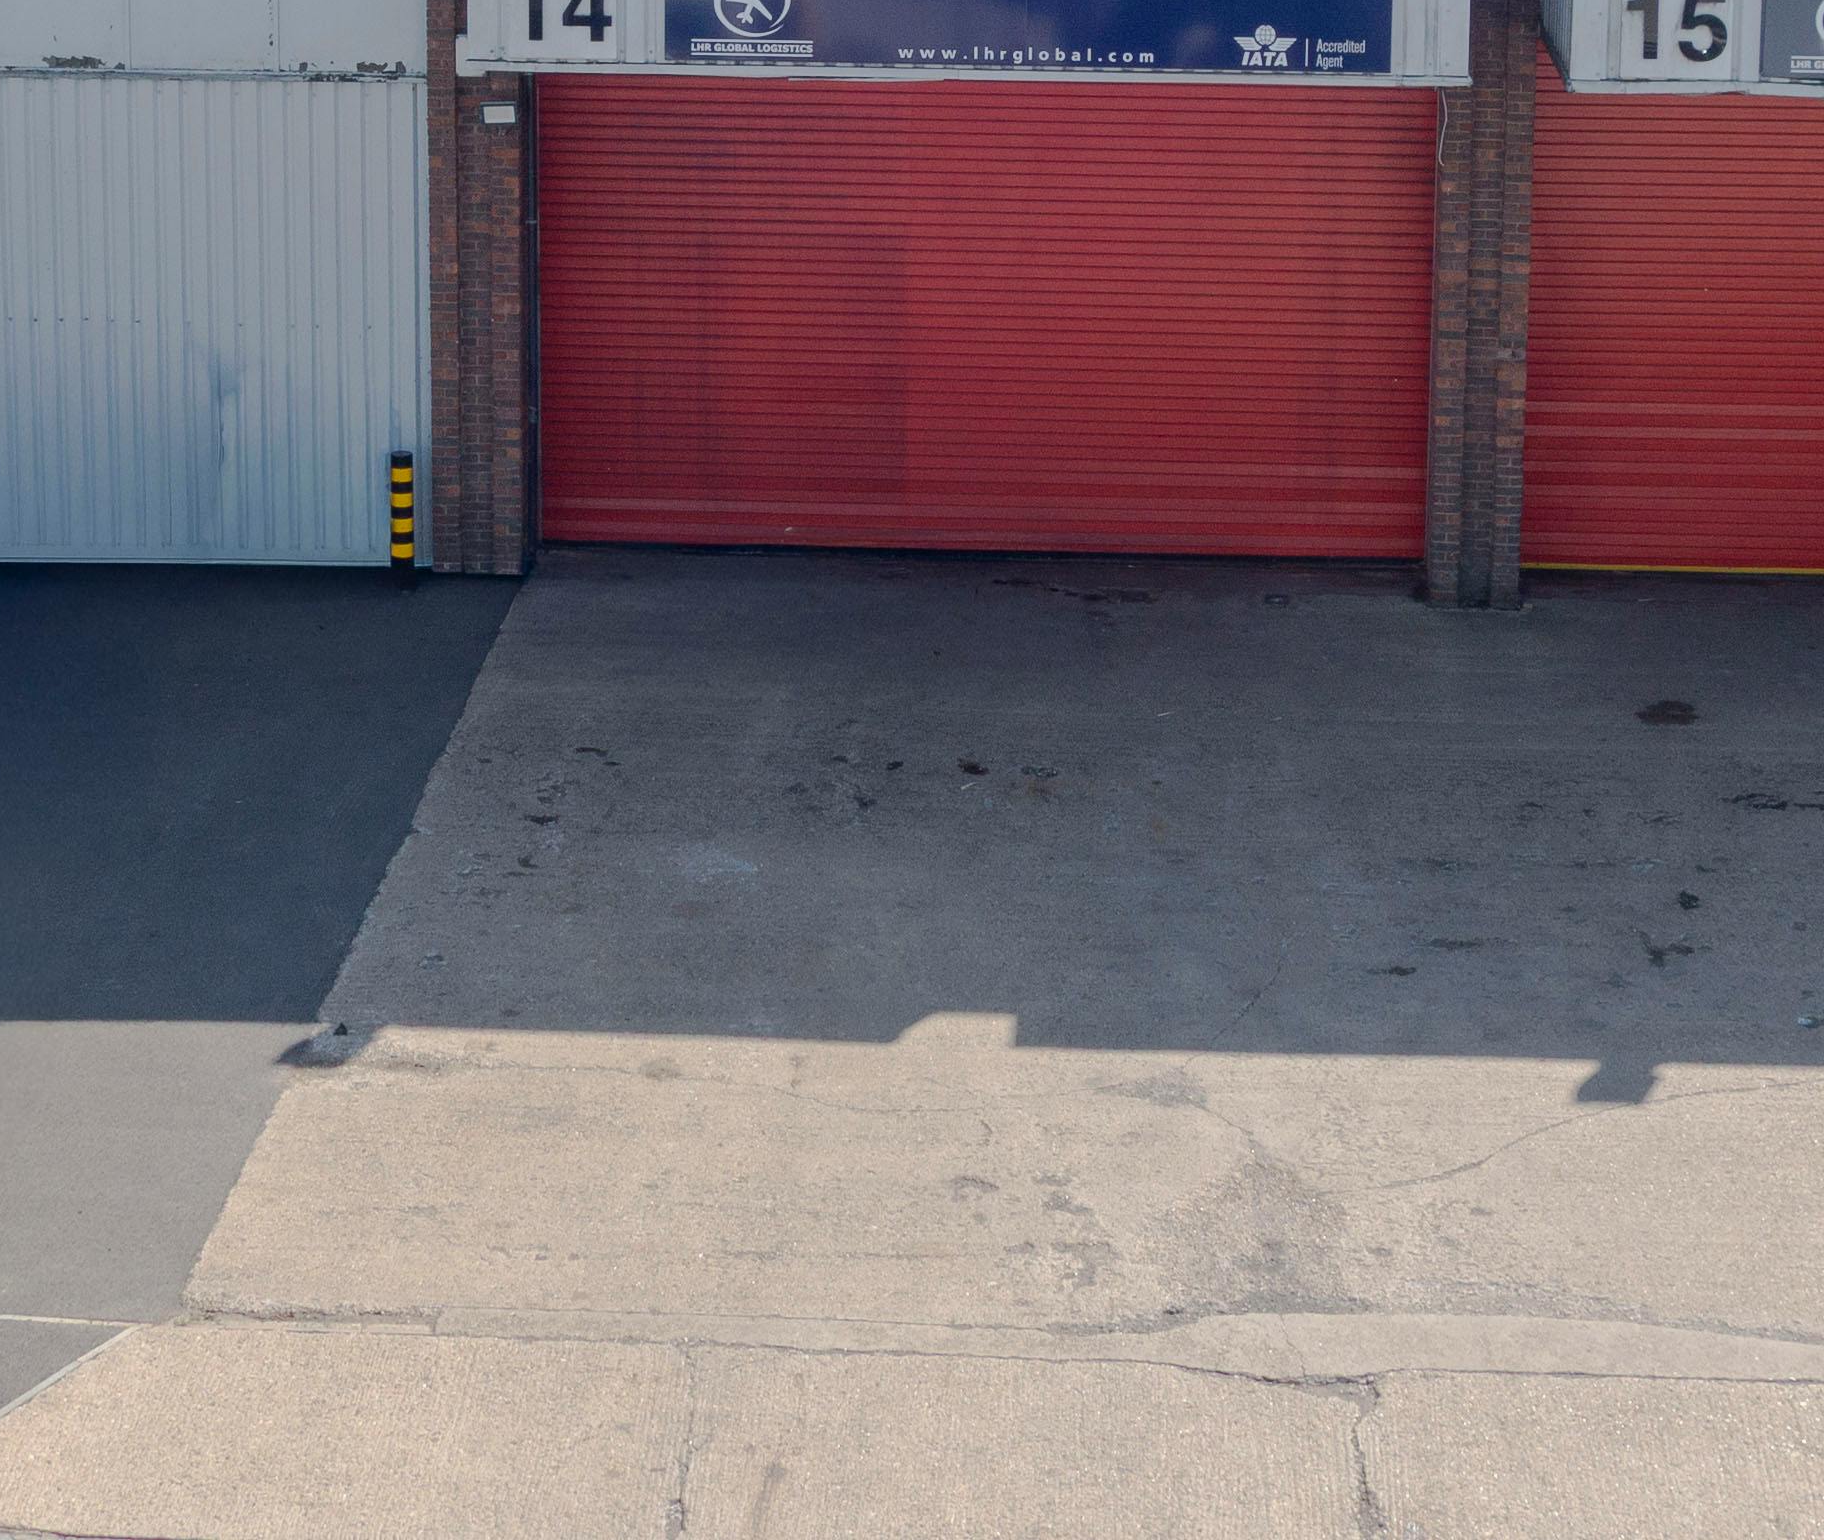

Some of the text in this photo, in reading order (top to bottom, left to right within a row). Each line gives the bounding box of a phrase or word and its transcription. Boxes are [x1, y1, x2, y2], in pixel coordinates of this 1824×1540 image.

[690, 42, 814, 54] LHR GLOBAL LOGISTICS
[1316, 38, 1366, 54] Accredited
[898, 46, 1155, 64] www.lhrglobal.com
[1241, 51, 1289, 67] IATA
[1315, 54, 1344, 70] Agent
[1790, 60, 1812, 69] LHR
